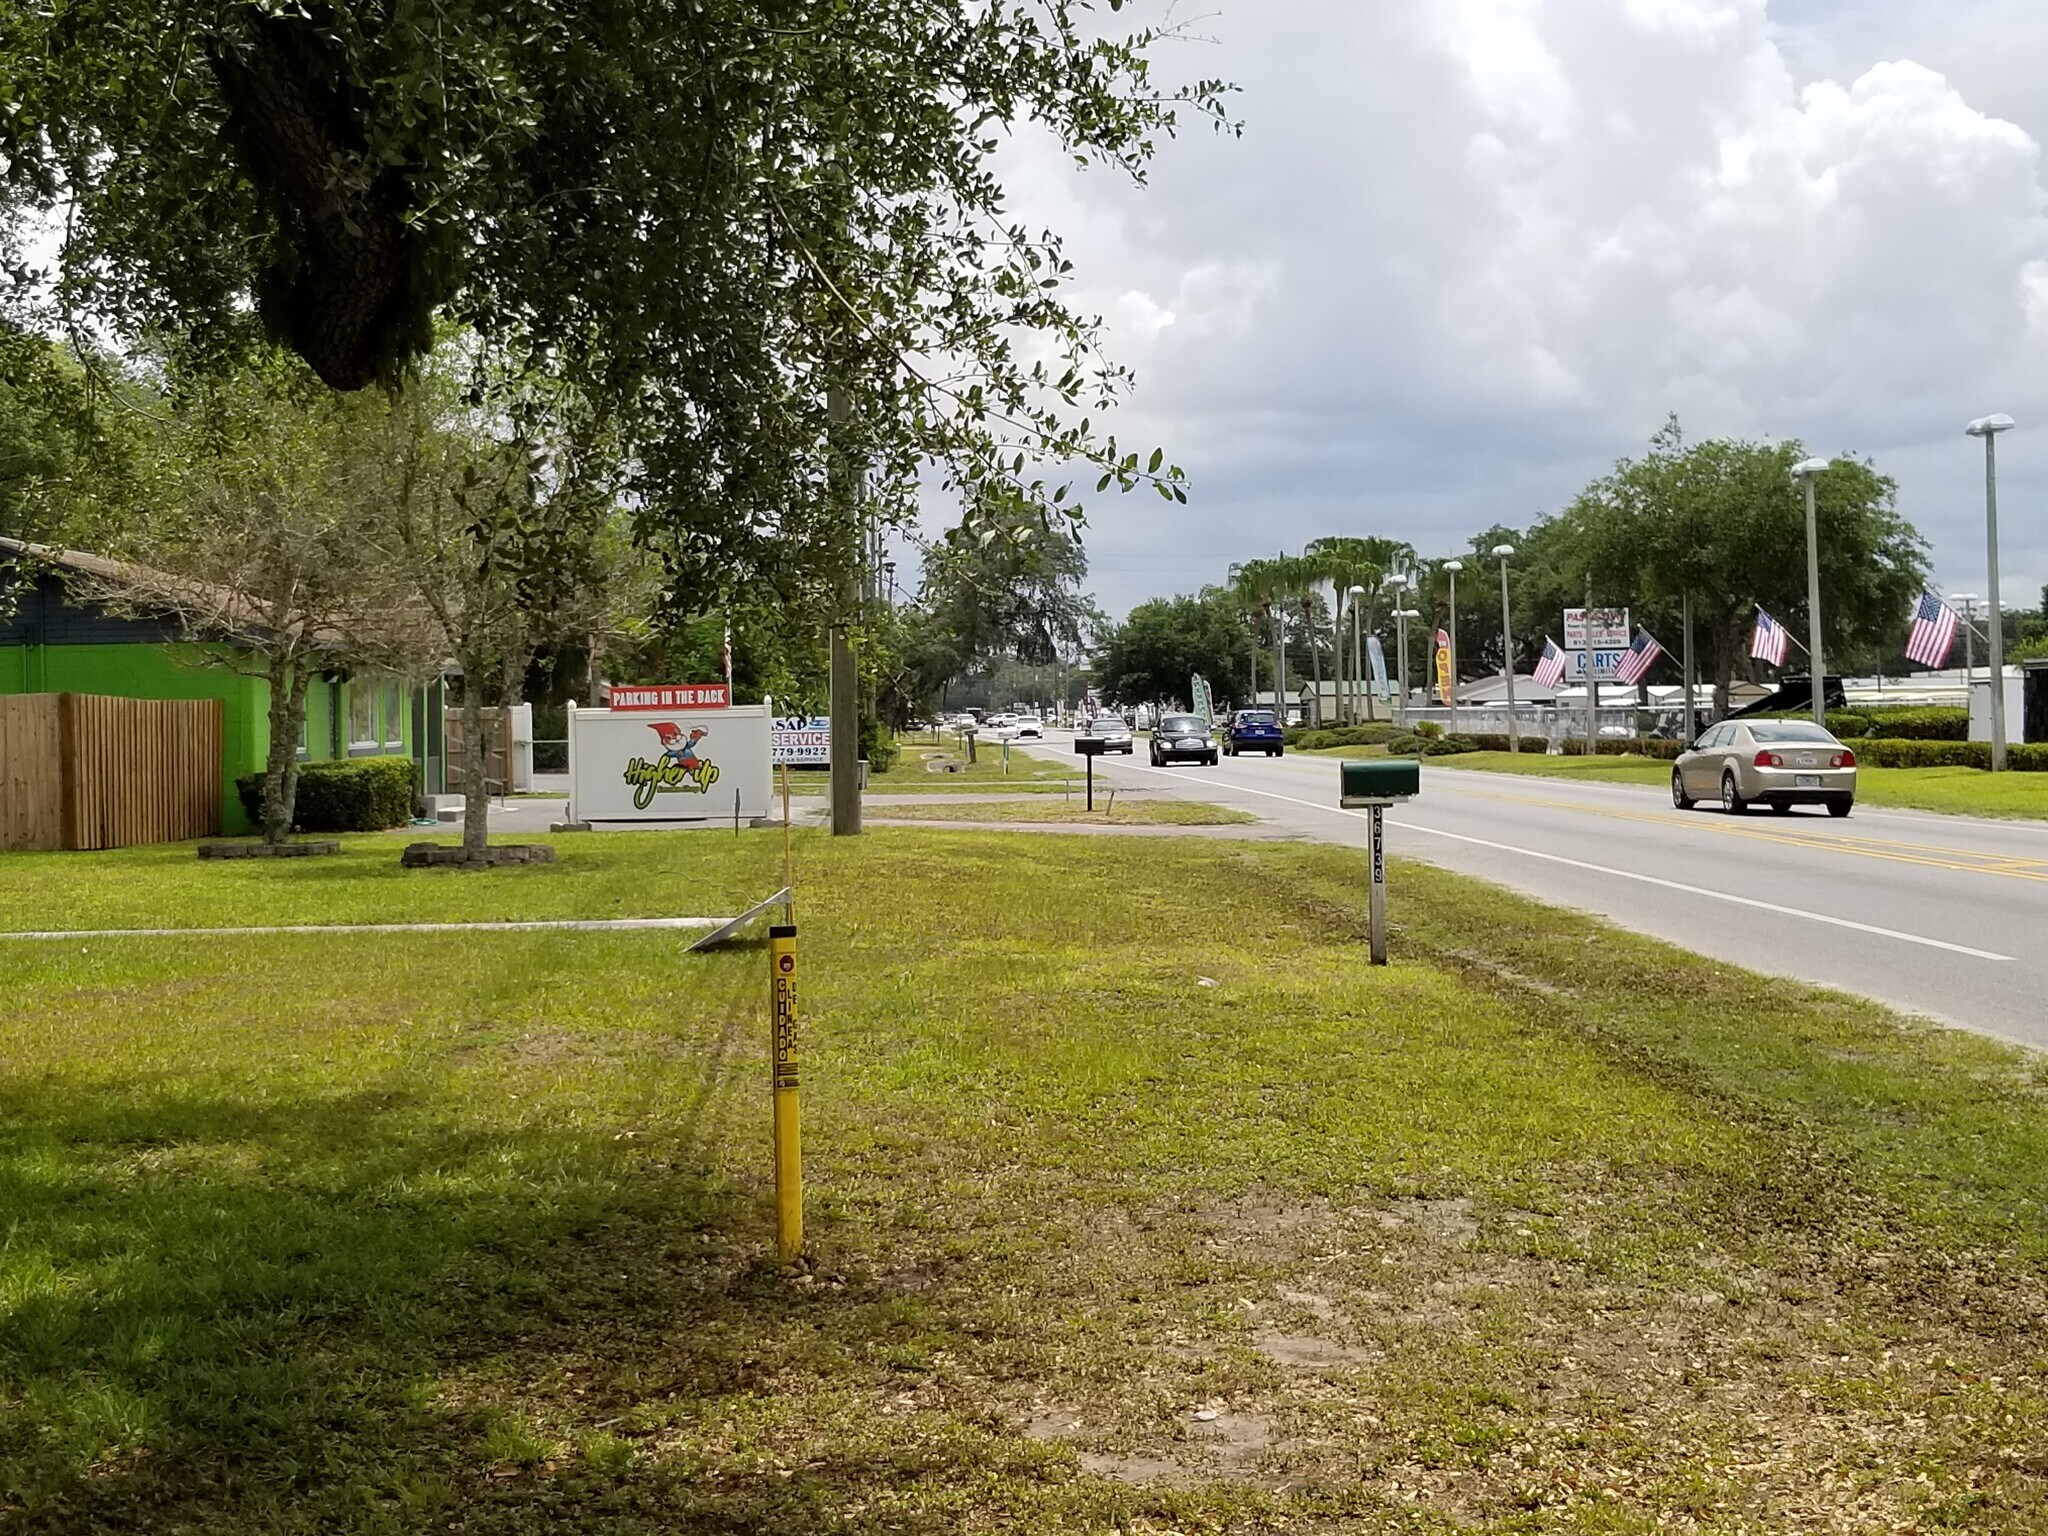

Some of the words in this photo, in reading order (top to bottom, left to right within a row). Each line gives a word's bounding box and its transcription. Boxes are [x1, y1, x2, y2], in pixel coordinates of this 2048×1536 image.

[1577, 653, 1620, 668] CRTS
[613, 691, 659, 706] PARKING
[661, 691, 673, 705] IN
[675, 690, 695, 704] THE
[697, 689, 725, 704] BACK
[771, 719, 807, 731] SAP
[772, 732, 831, 746] SERVICE
[772, 747, 827, 756] 779-9922
[623, 757, 688, 810] Higher
[1374, 806, 1382, 881] 36739
[778, 979, 787, 1061] CUIDADO
